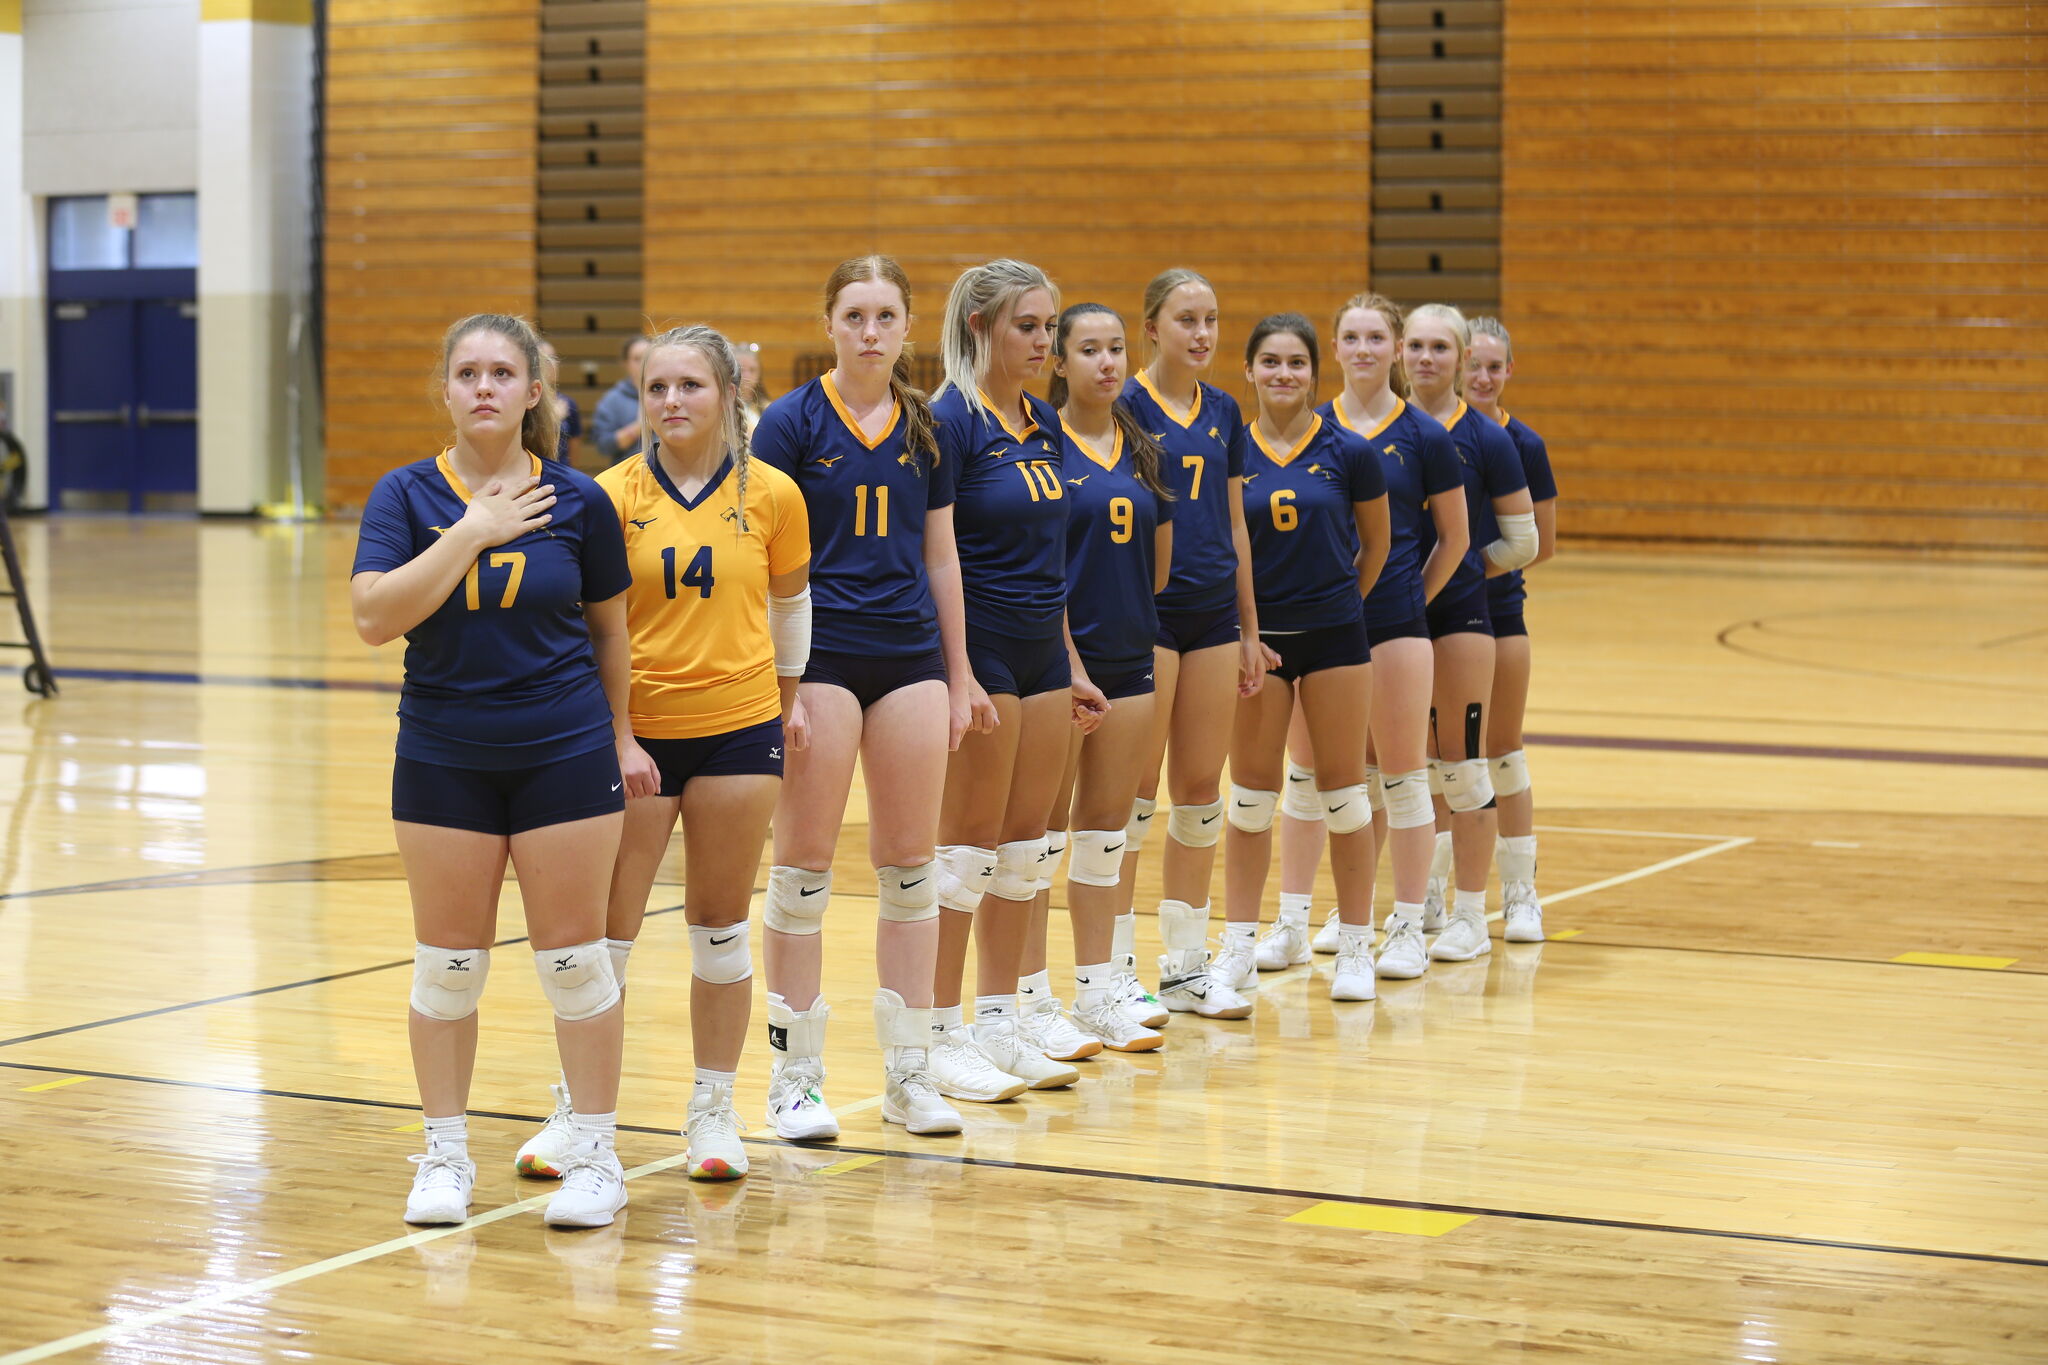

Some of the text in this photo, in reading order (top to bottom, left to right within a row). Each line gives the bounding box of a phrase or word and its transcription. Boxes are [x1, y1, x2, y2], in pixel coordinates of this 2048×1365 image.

[1015, 460, 1064, 502] 10
[1182, 455, 1205, 500] 7
[855, 484, 889, 537] 11
[1109, 497, 1133, 544] 9
[1270, 489, 1298, 531] 6
[465, 551, 527, 611] 17
[661, 545, 715, 600] 14
